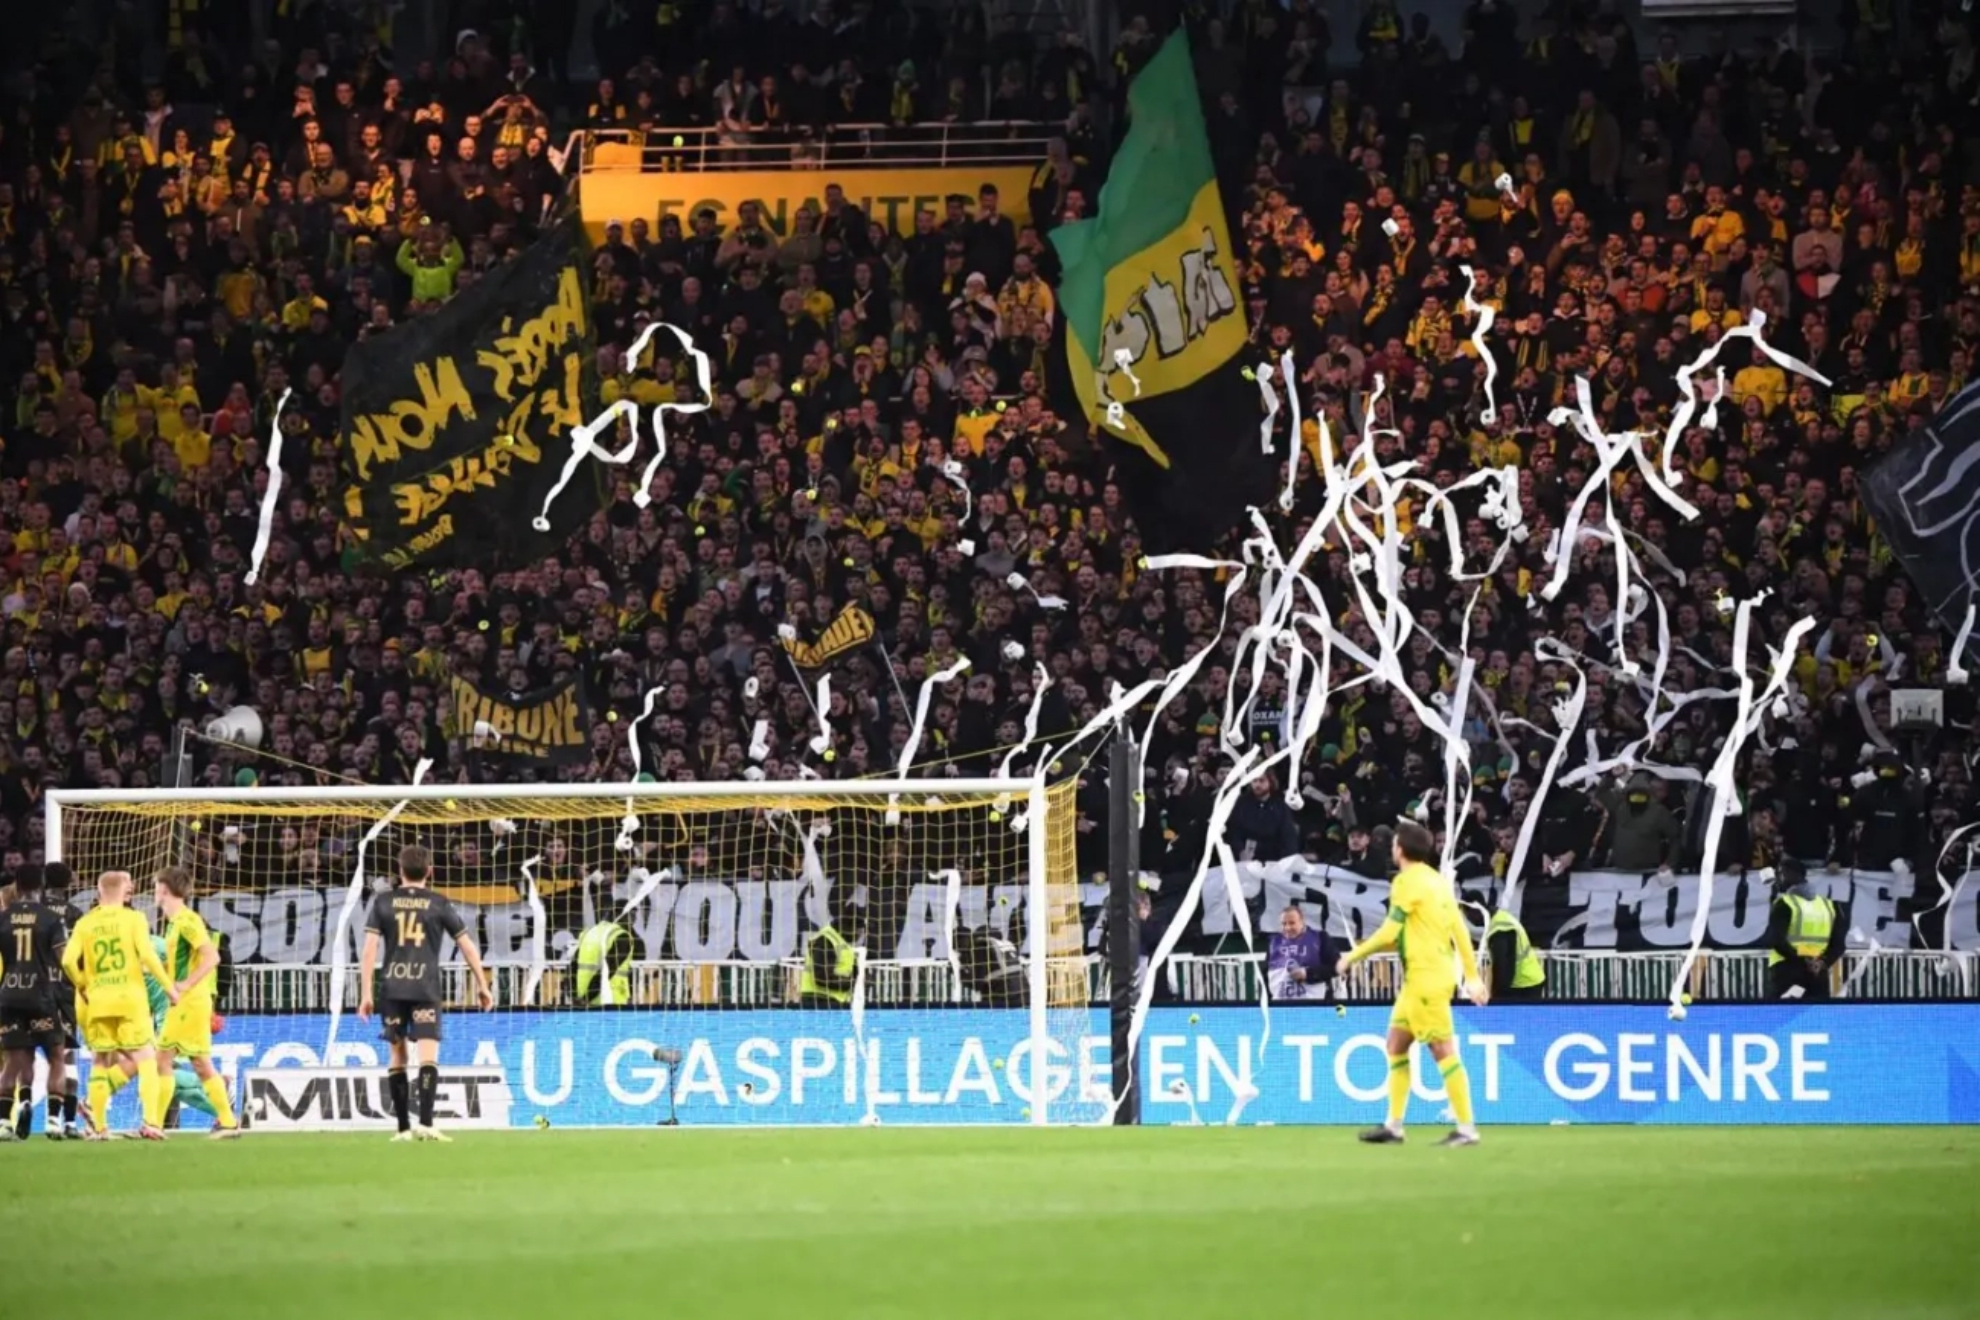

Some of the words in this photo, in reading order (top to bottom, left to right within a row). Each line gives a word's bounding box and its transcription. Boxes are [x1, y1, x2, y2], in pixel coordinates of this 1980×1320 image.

[451, 674, 585, 747] TRIBUNE
[394, 911, 425, 948] 14
[1569, 868, 1916, 948] TOUE
[12, 927, 32, 962] 11
[93, 937, 126, 973] 25
[602, 1036, 1114, 1107] GASPILLAGE
[1149, 1034, 1252, 1103] EN
[1543, 1031, 1831, 1103] GENRE
